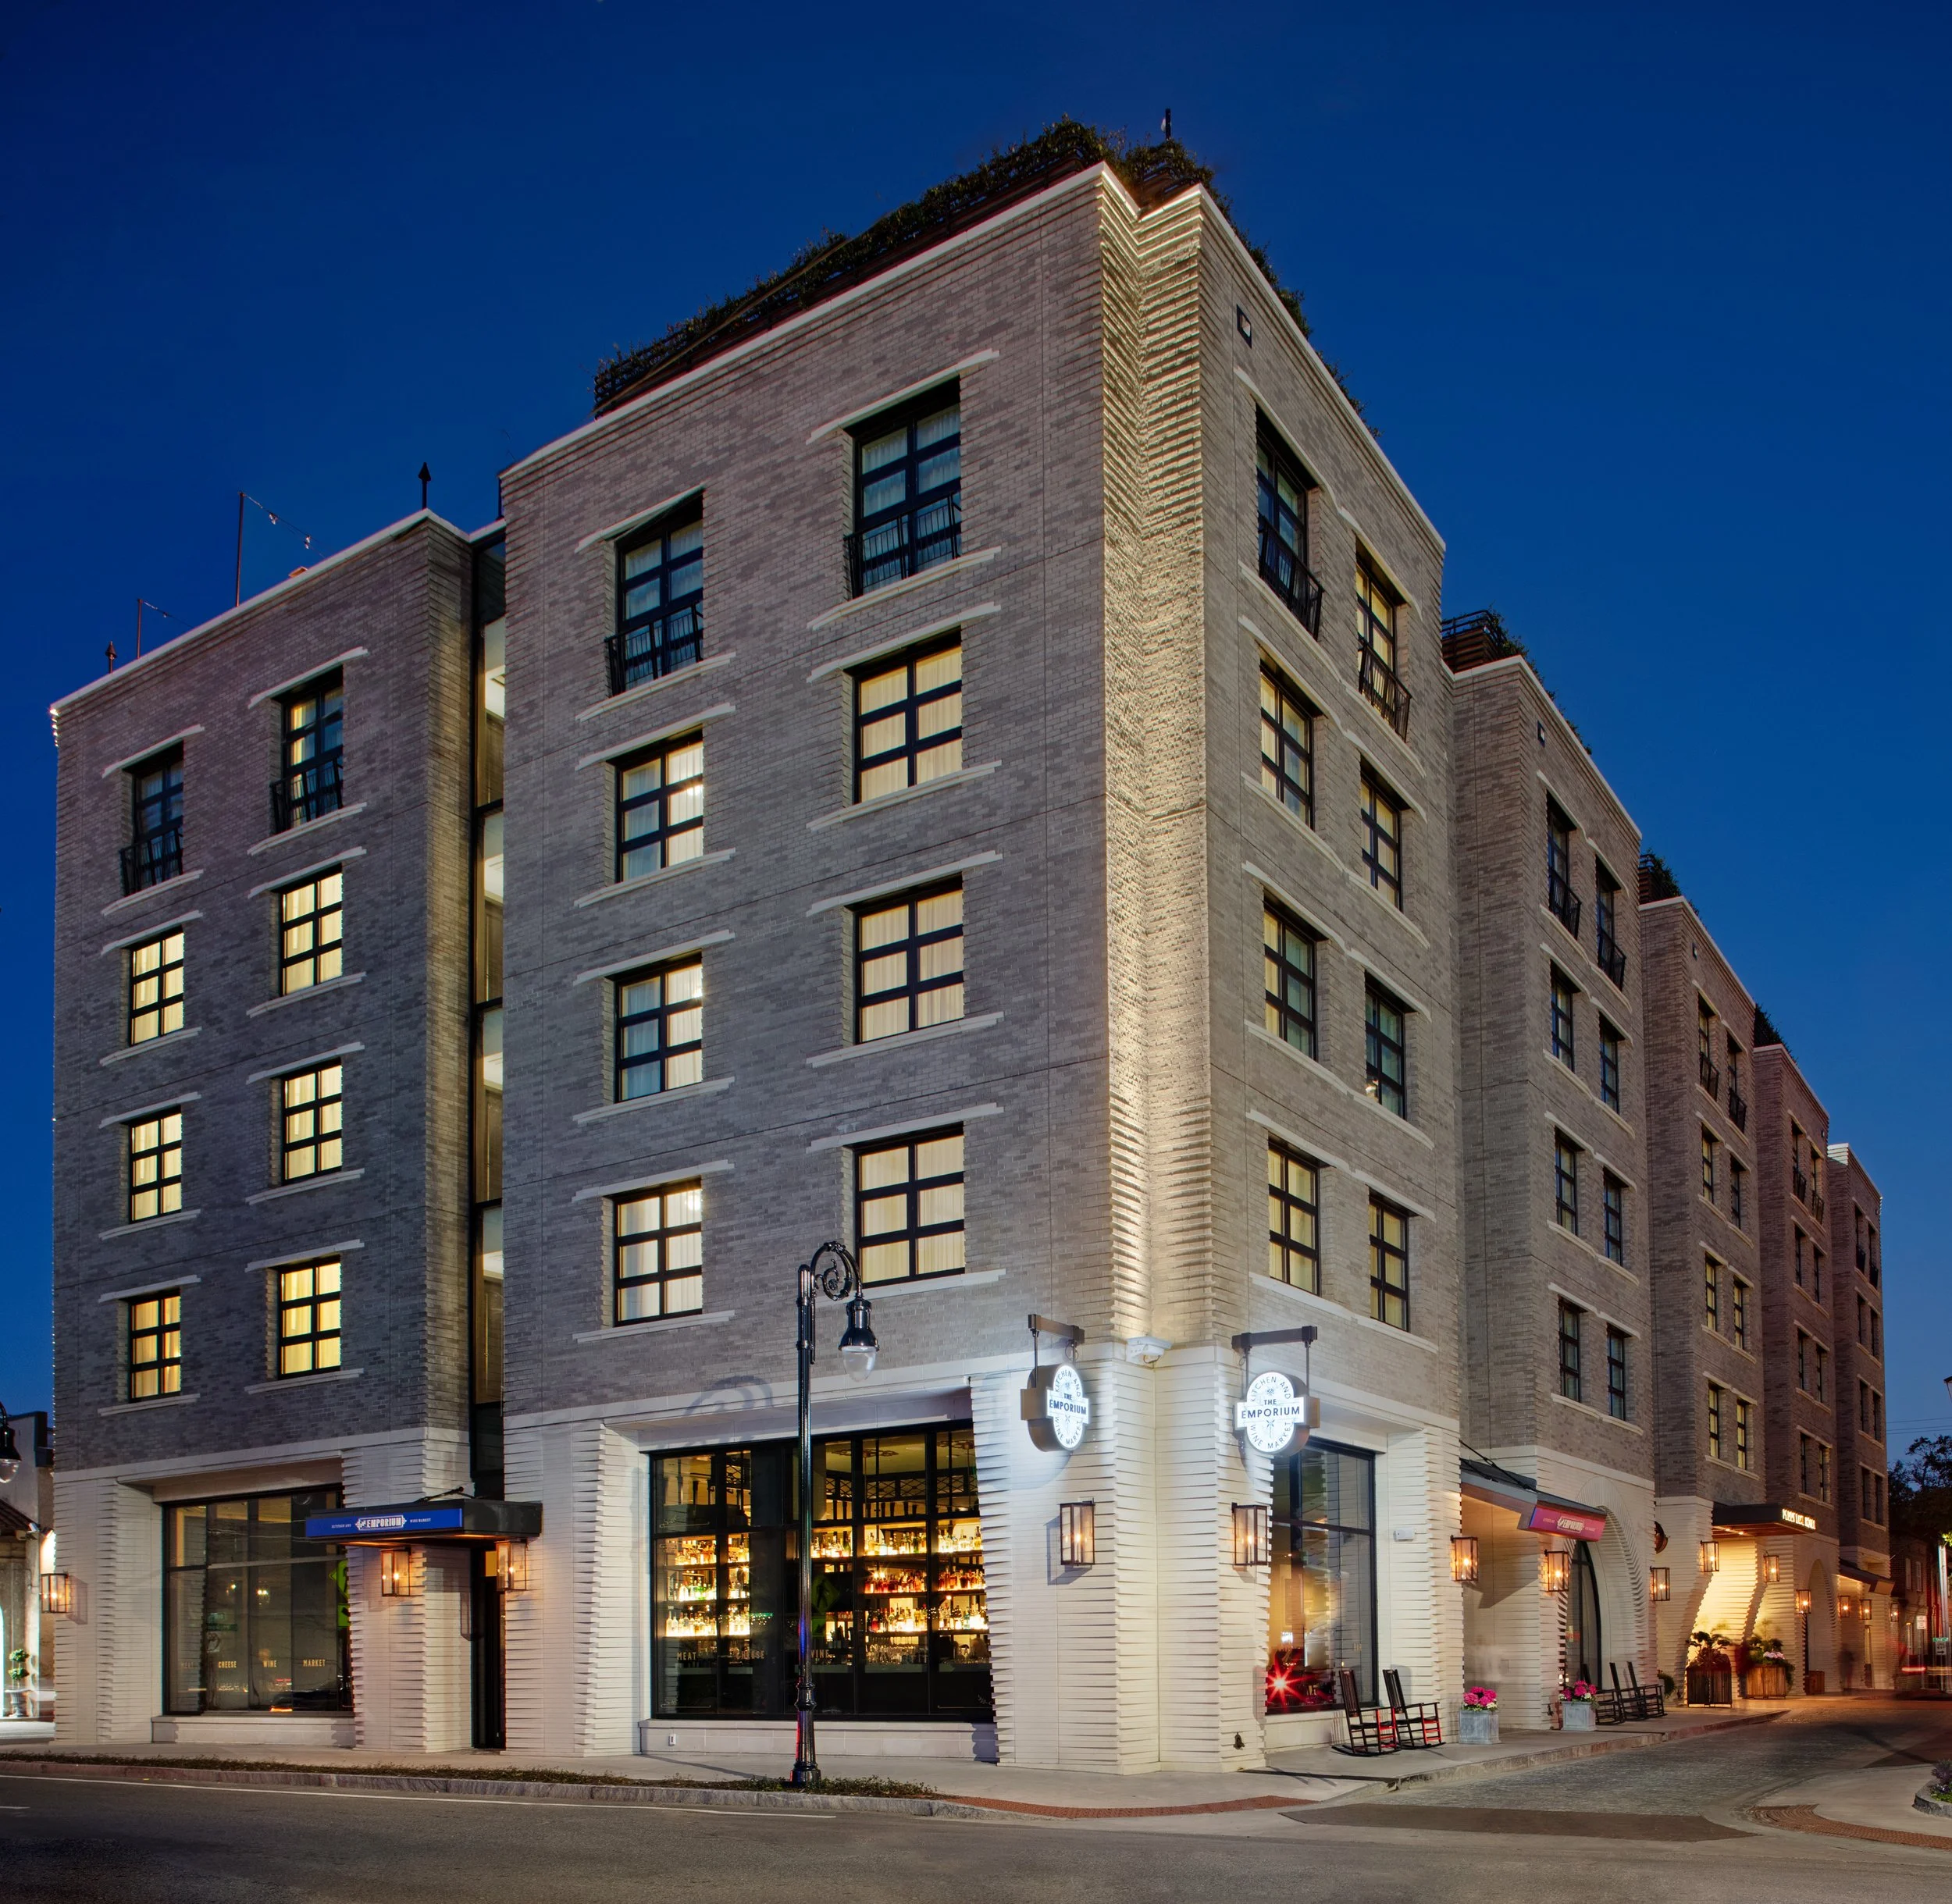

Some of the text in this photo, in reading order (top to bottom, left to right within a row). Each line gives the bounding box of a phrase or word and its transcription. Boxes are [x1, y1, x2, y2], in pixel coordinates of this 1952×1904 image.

[1055, 1369, 1072, 1392] KITCHEN
[1250, 1376, 1291, 1402] KITCHEN AND
[1049, 1399, 1087, 1415] EMPORIUM
[1241, 1406, 1300, 1419] EMPORIUM
[1055, 1416, 1083, 1445] WINE MARKET
[1250, 1422, 1291, 1450] WINE MARKET
[366, 1517, 401, 1529] EMPORIUM
[303, 1659, 326, 1667] MARKET
[677, 1652, 696, 1660] MEAT
